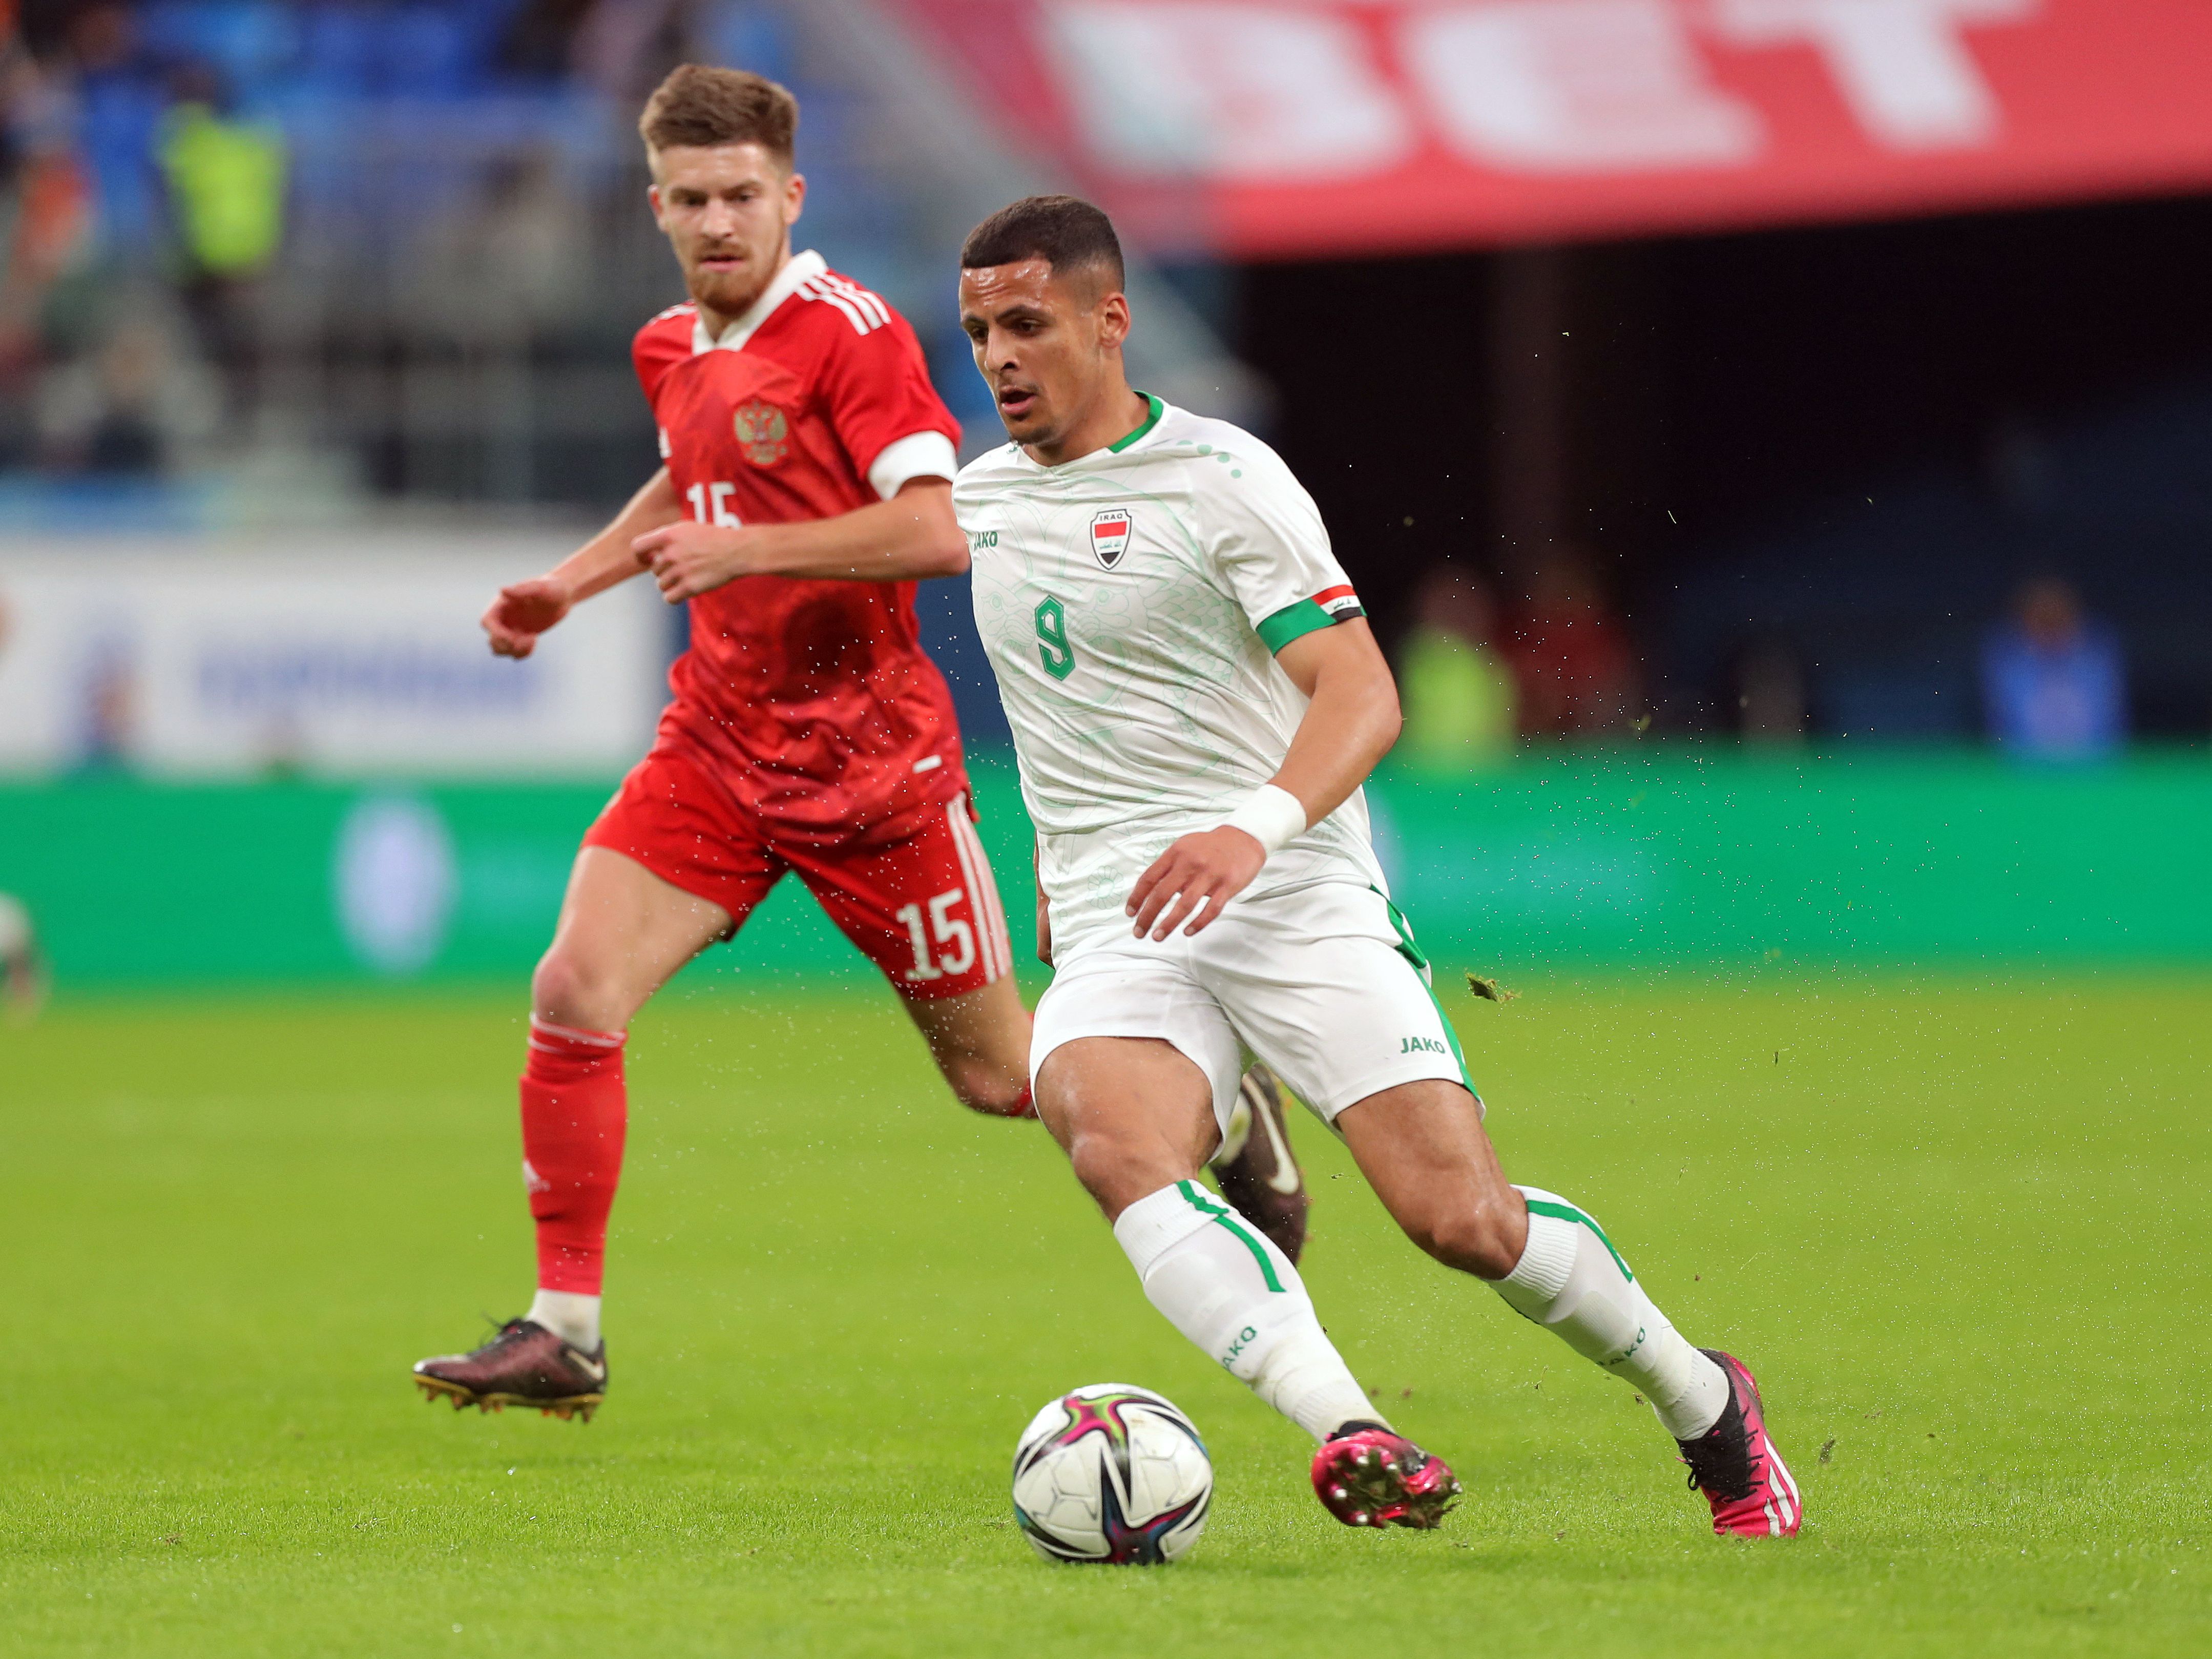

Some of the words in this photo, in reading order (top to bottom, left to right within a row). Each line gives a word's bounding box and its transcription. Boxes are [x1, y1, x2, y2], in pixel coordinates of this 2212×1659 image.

[1035, 595, 1075, 681] 9
[896, 887, 975, 981] 15
[1401, 1037, 1445, 1054] JAKO
[1222, 1326, 1257, 1371] AKO
